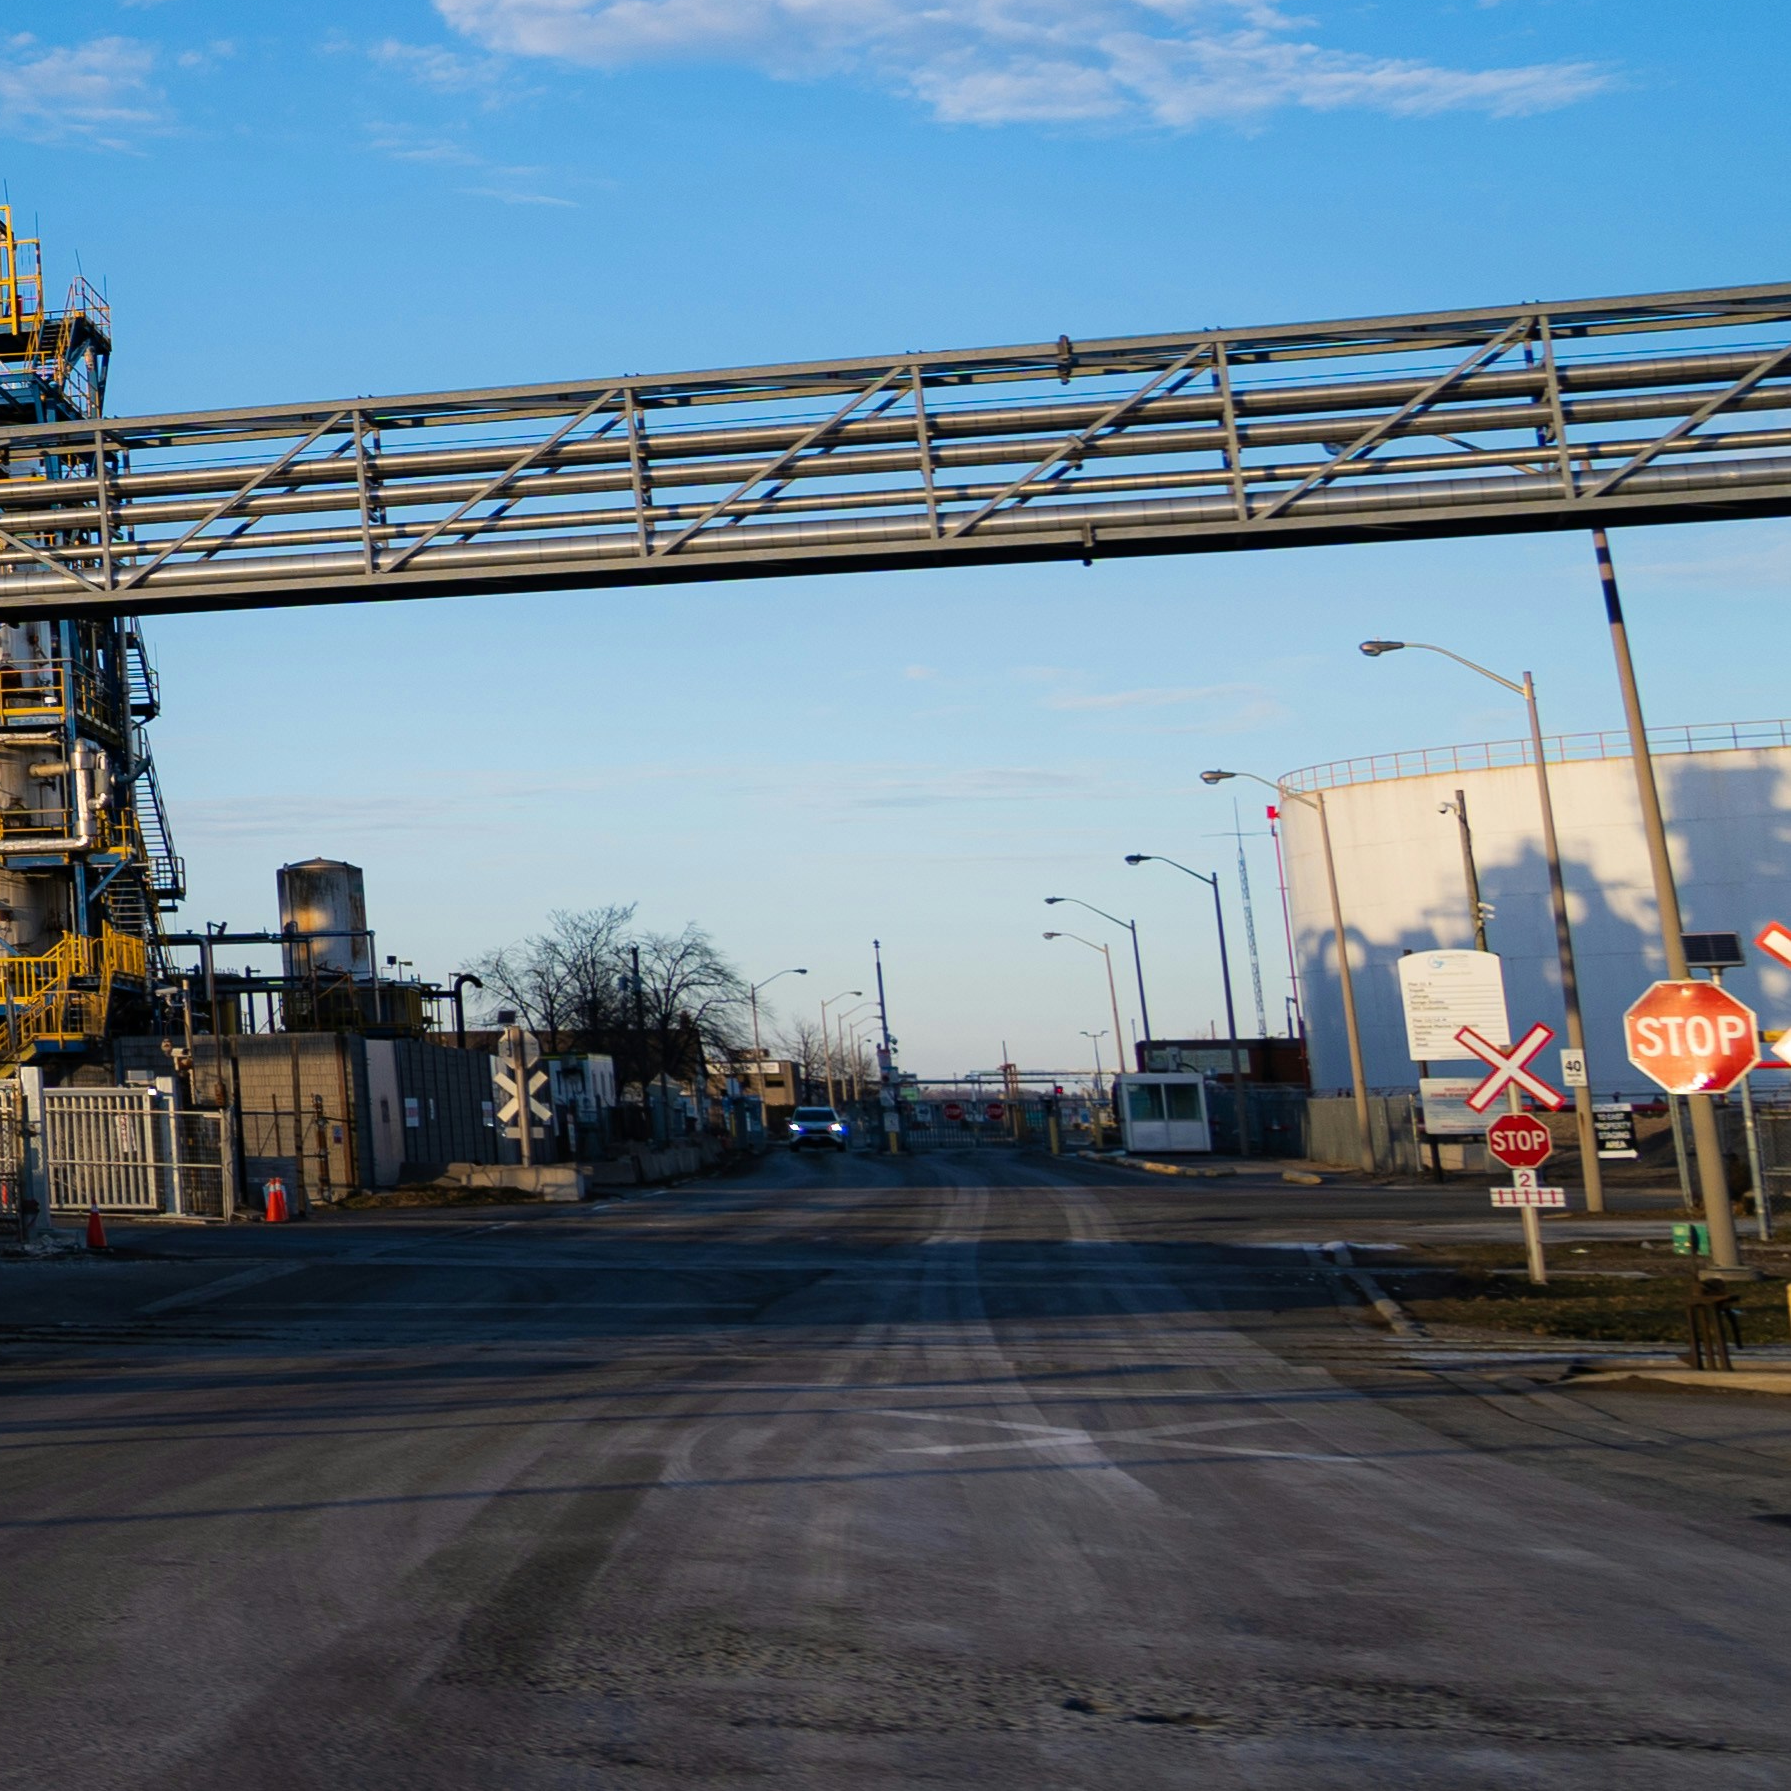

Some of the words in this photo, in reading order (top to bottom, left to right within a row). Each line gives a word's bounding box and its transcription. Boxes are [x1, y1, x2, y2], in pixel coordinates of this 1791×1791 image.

[1636, 1015, 1746, 1057] STOP
[1565, 1060, 1582, 1072] 40
[1491, 1130, 1546, 1152] STOP
[1518, 1173, 1531, 1188] 2
